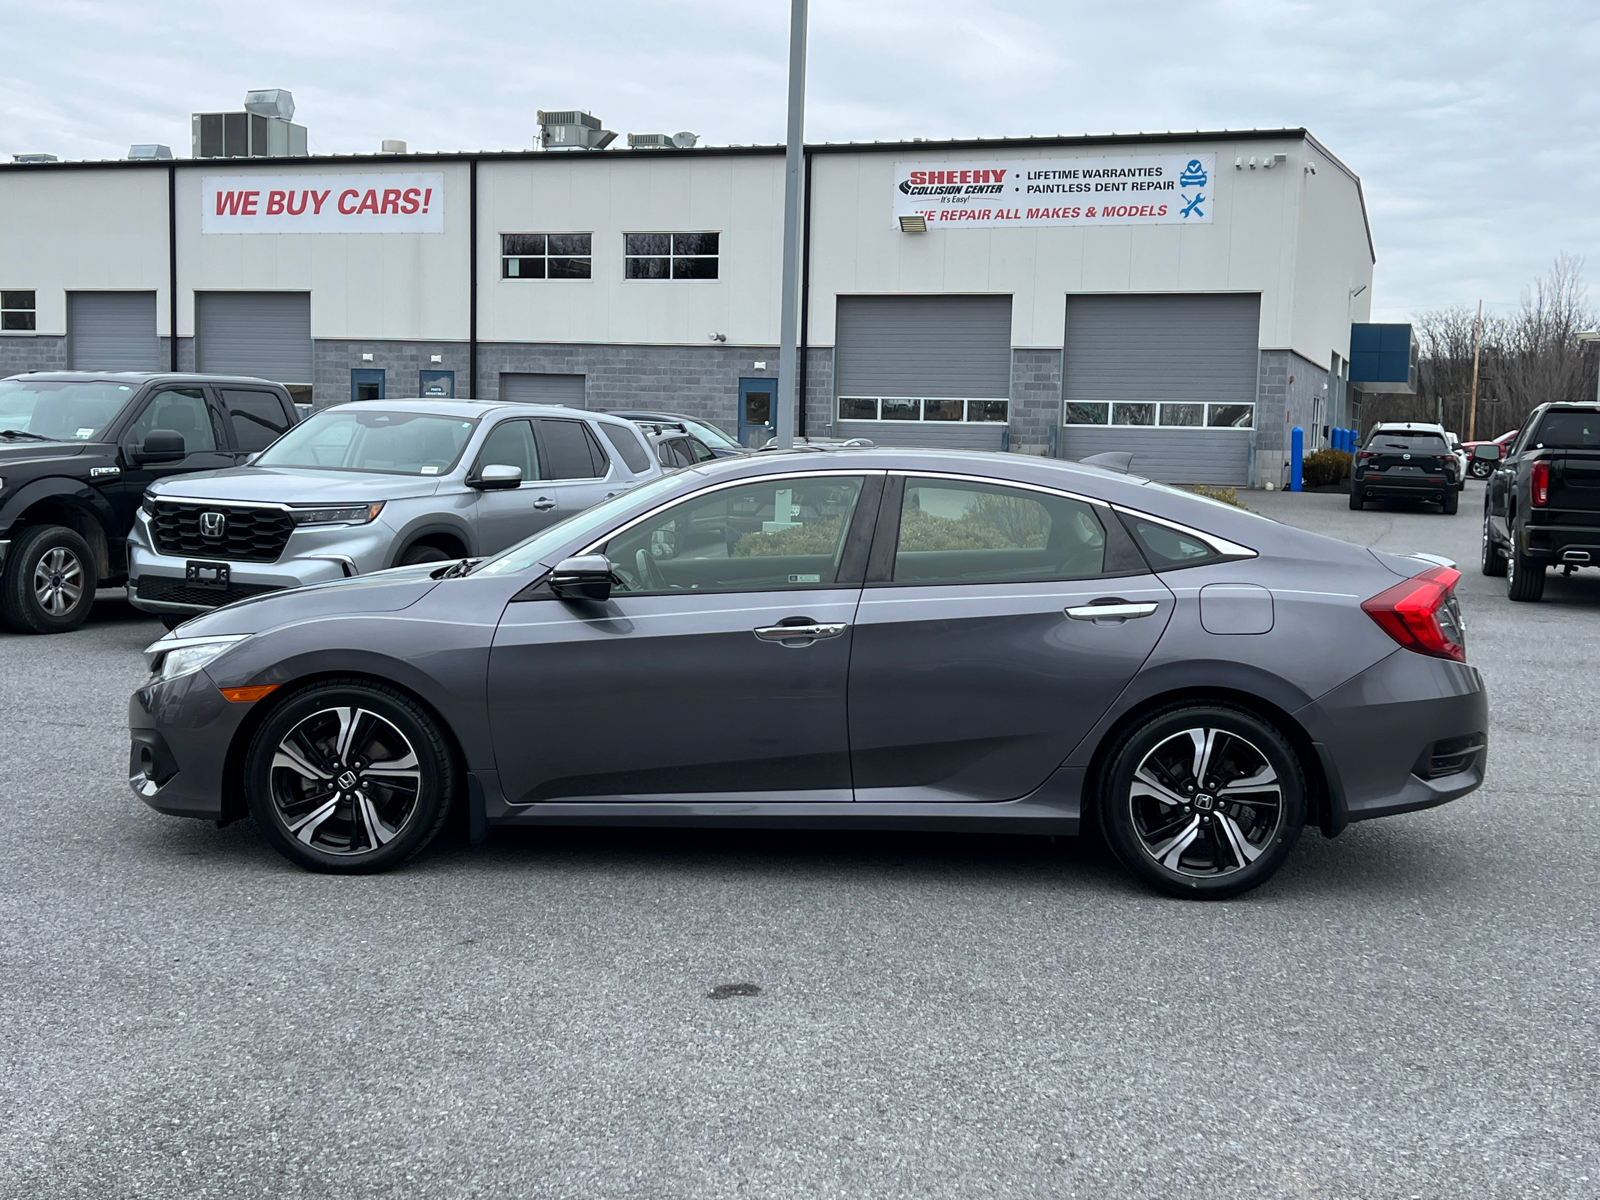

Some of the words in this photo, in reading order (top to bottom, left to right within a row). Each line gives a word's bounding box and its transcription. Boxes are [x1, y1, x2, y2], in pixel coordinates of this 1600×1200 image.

[910, 169, 1007, 185] SHEEHY
[1027, 169, 1079, 181] LIFETIME
[1082, 167, 1163, 179] WARRANTIES
[910, 185, 963, 195] COLLISION
[964, 184, 1004, 194] CENTER
[1027, 183, 1091, 194] PAINTLESS
[1094, 182, 1128, 192] DENT
[1131, 181, 1175, 191] REPAIR
[215, 190, 260, 216] WE
[266, 189, 331, 216] BUY
[337, 188, 433, 215] CARS!
[951, 195, 971, 204] Easy!
[914, 210, 937, 221] E
[940, 209, 992, 221] REPAIR
[994, 208, 1021, 220] ALL
[1026, 206, 1081, 219] MAKES
[1085, 206, 1097, 218] &
[1102, 204, 1168, 217] MODELS
